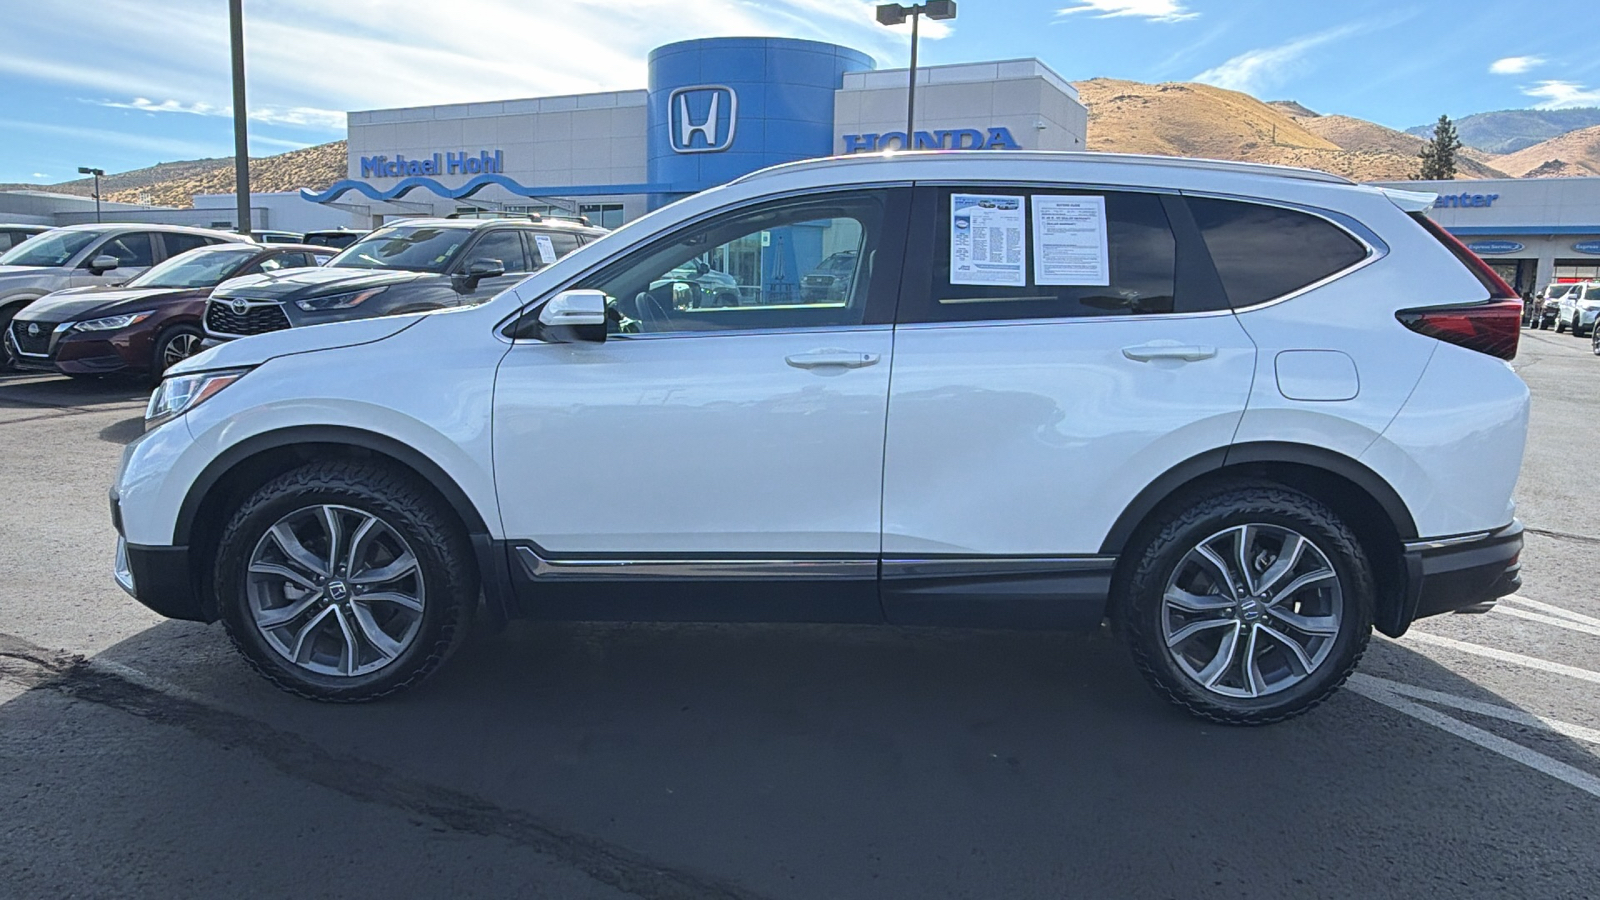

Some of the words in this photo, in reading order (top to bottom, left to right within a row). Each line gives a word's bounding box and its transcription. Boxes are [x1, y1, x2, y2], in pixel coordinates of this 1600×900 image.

[842, 126, 1023, 154] HONDA
[360, 152, 442, 178] Michael
[446, 150, 503, 175] Hohl
